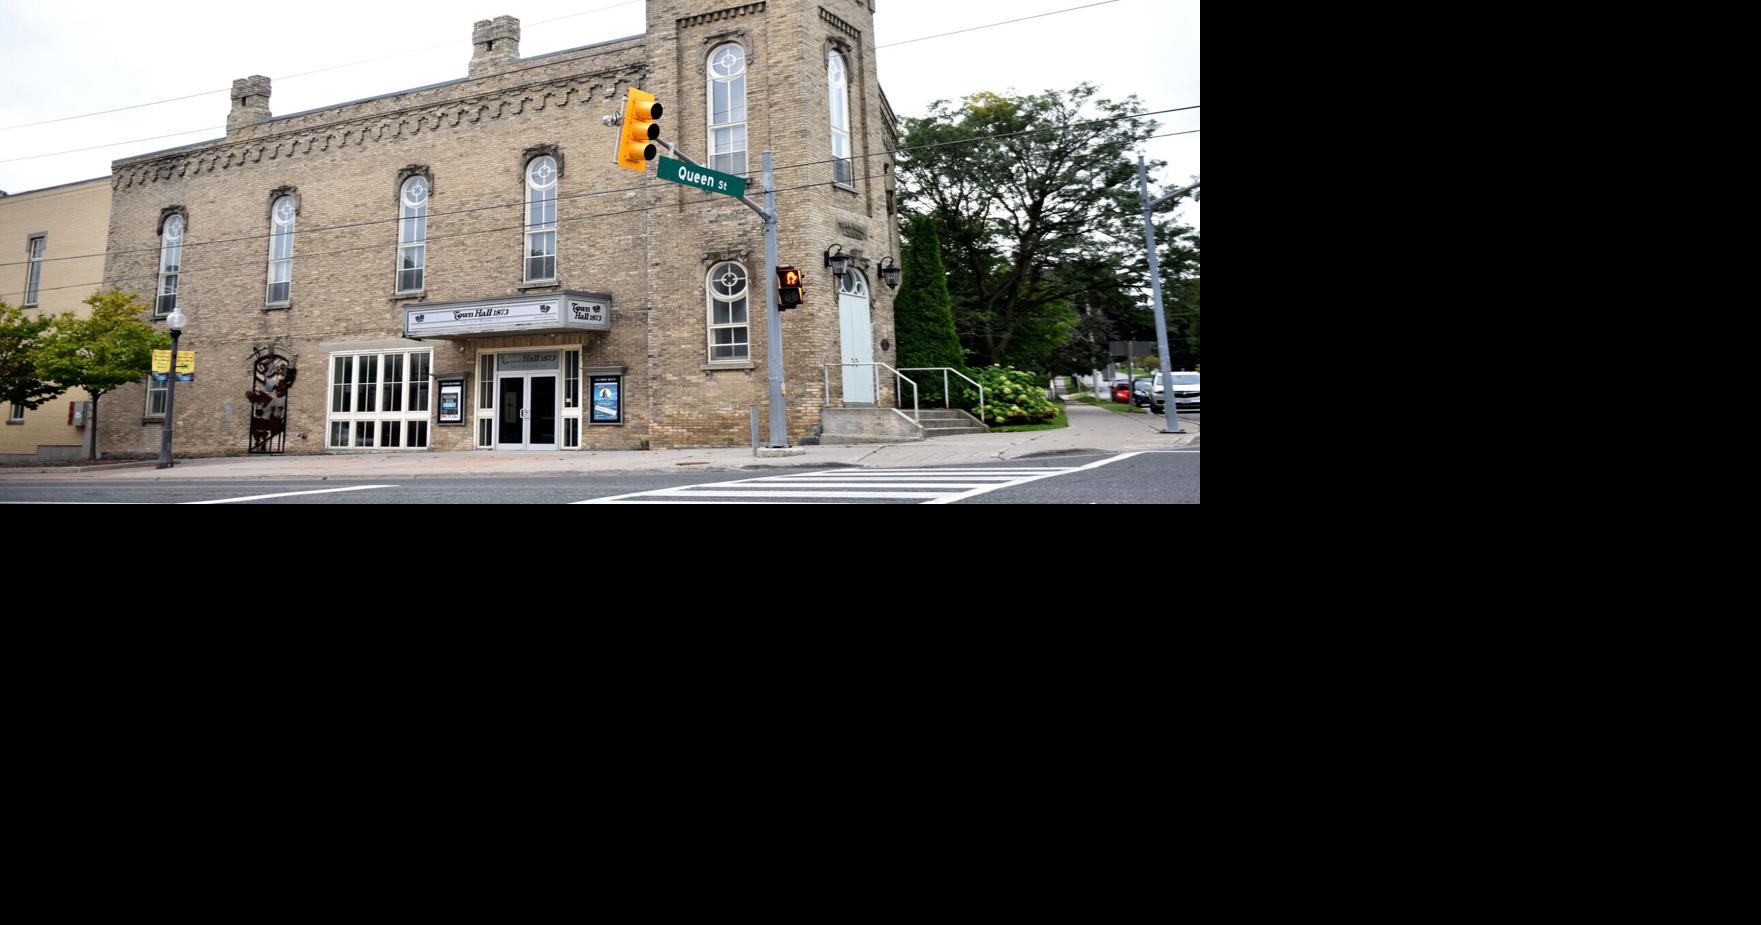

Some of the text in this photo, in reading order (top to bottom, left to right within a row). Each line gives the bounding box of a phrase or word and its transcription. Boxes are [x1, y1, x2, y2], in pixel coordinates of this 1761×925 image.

[678, 166, 714, 187] Queen
[572, 303, 590, 313] Town
[453, 310, 474, 321] Town
[474, 308, 493, 318] Hall
[575, 312, 589, 320] Hall
